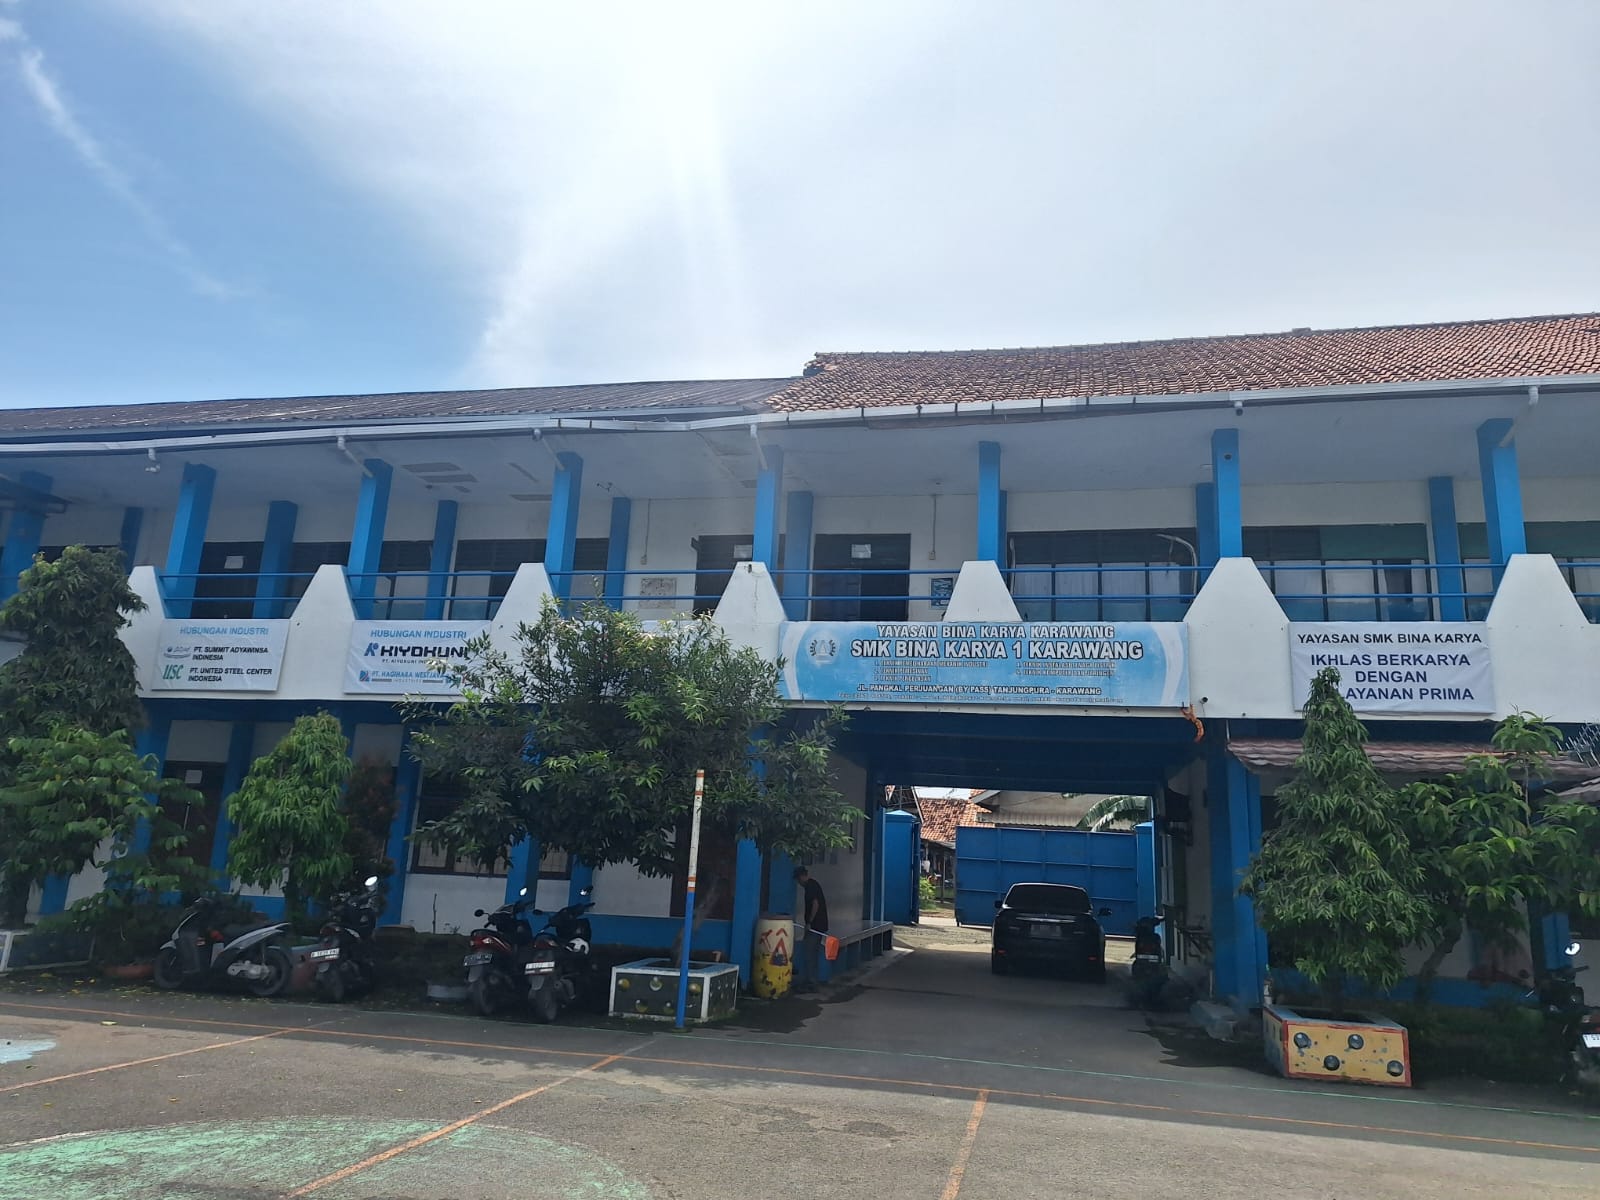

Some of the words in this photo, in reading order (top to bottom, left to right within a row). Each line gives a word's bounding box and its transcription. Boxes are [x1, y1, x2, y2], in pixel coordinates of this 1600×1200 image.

[180, 626, 227, 635] HUBUNGAN
[229, 627, 269, 635] INDUSTRI
[370, 629, 421, 638] HUBUNGAN
[423, 630, 467, 639] INDUSTRI
[877, 624, 937, 638] YAYASAN
[941, 624, 976, 638] BINA
[980, 625, 1026, 639] KARYA
[1030, 625, 1115, 639] KARAWANG
[1297, 633, 1360, 644] YAYASAN
[1363, 633, 1394, 644] SMK
[1398, 633, 1432, 643] BINA
[1434, 633, 1482, 643] KARYA
[230, 646, 269, 654] ADYAWINSA
[380, 645, 468, 658] KIYOKUNI
[851, 639, 892, 658] SMK
[895, 639, 940, 658] BINA
[944, 640, 1008, 659] KARYA
[1012, 641, 1023, 659] 1
[1029, 640, 1144, 660] KARAWANG
[1310, 654, 1372, 666] IKHLAS
[1377, 654, 1471, 666] BERKARYA
[1355, 670, 1428, 683] DENGAN
[857, 683, 869, 691] JL.
[869, 684, 902, 692] PANGKAL
[904, 685, 954, 693] PERJUANGAN
[955, 685, 969, 694] (BY
[970, 685, 991, 695] PASS)
[993, 686, 1050, 695] TANJUNGPURA
[1056, 686, 1102, 695] KARAWANG
[1337, 687, 1415, 701] AYANAN
[1419, 687, 1475, 701] PRIMA
